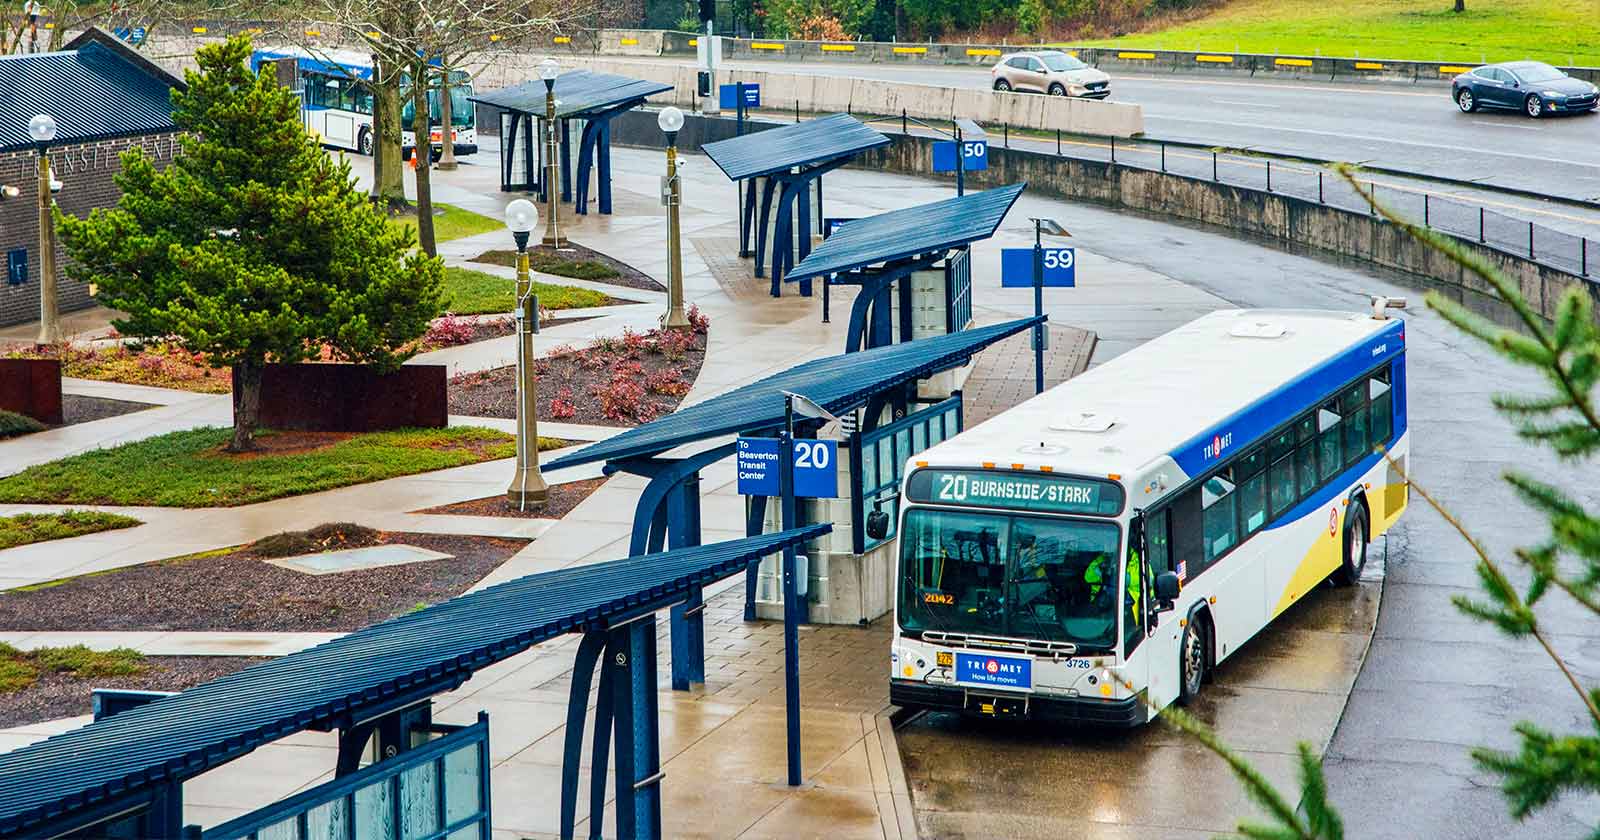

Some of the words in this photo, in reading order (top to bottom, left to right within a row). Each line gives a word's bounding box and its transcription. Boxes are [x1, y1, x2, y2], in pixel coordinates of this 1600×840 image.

[964, 142, 984, 157] 50
[1044, 250, 1073, 268] 59
[739, 440, 749, 449] To
[1204, 443, 1214, 460] TRI
[1220, 431, 1232, 450] MET
[739, 451, 778, 460] Beaverton
[795, 442, 829, 469] 20
[739, 460, 766, 470] Transit
[739, 471, 765, 480] Center
[939, 474, 968, 501] 20
[971, 480, 1091, 503] BURNSIDE/STARK
[925, 593, 954, 605] 2042
[967, 660, 985, 670] TRI
[1000, 664, 1022, 674] MET
[1066, 658, 1090, 669] 3726
[987, 674, 996, 682] life
[997, 676, 1017, 684] moves
